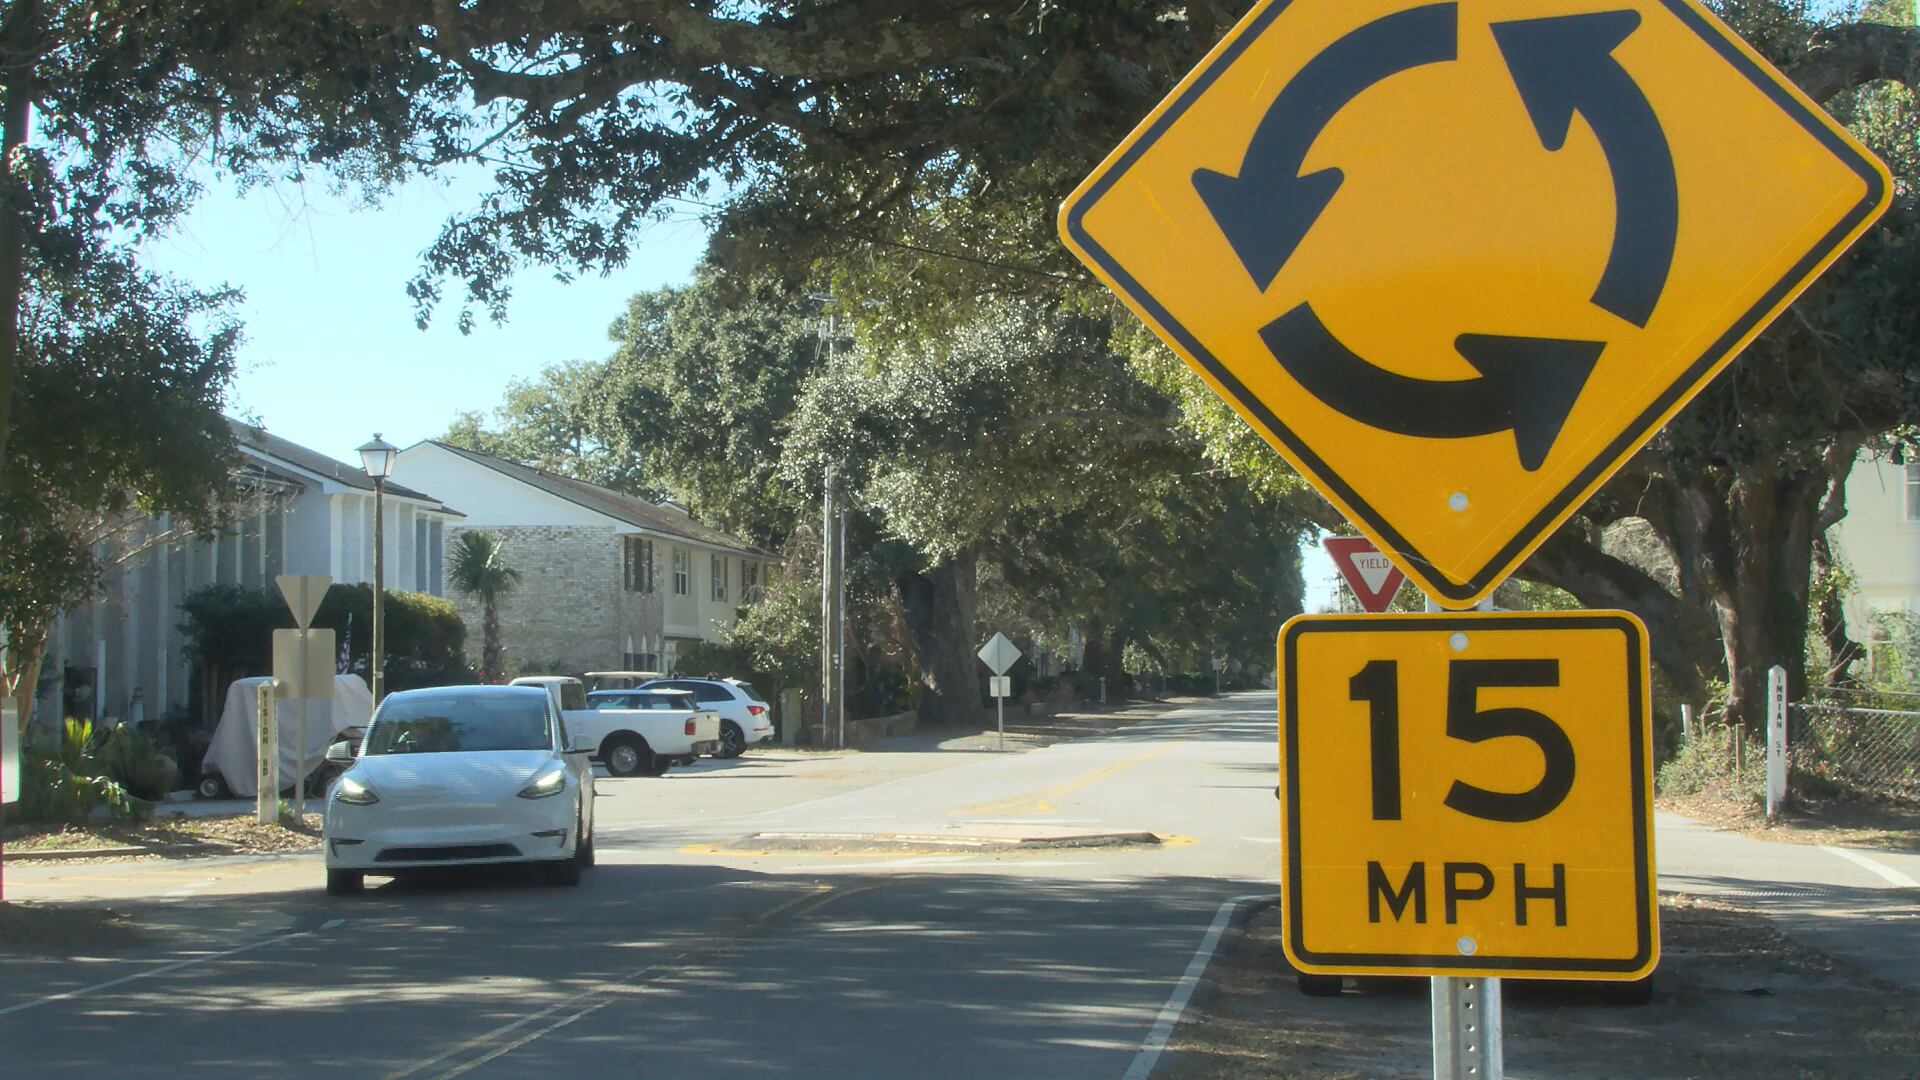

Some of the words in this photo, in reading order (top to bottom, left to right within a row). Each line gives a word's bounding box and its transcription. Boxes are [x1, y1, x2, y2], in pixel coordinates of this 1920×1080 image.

[1359, 558, 1389, 569] YIELD
[1775, 675, 1783, 729] INDIAN
[1349, 658, 1576, 823] 15
[1775, 740, 1782, 757] ST
[1367, 860, 1567, 927] MPH
